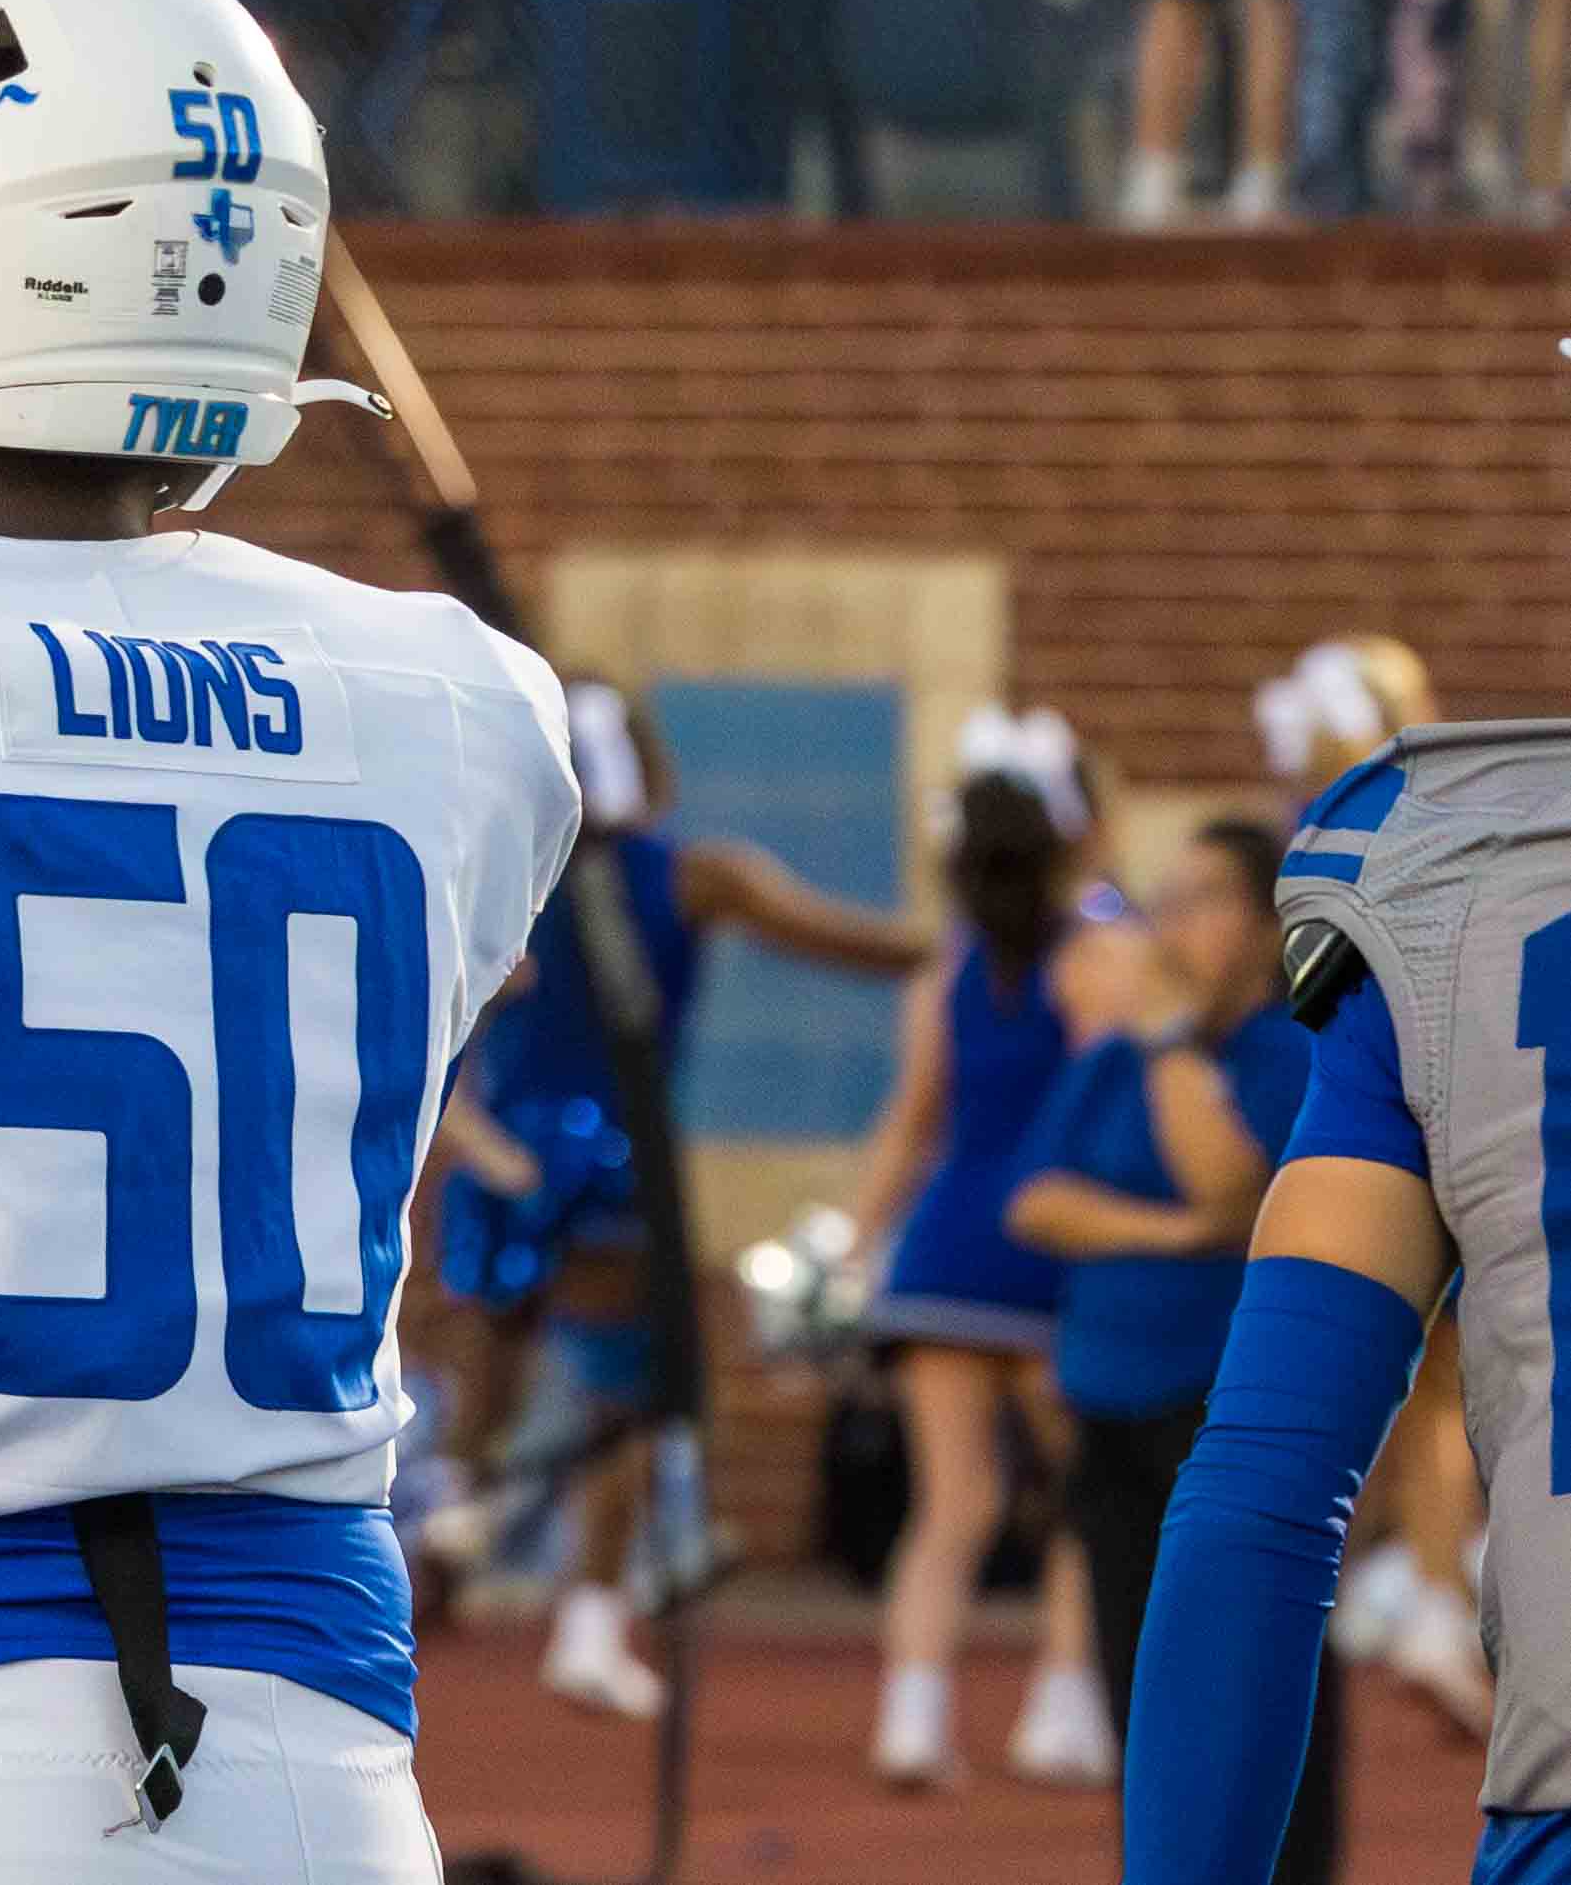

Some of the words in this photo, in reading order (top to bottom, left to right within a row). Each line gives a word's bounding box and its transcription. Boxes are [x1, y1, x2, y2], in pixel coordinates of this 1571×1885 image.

[168, 88, 262, 183] 50
[122, 393, 249, 458] TYLER
[30, 622, 304, 756] LIONS
